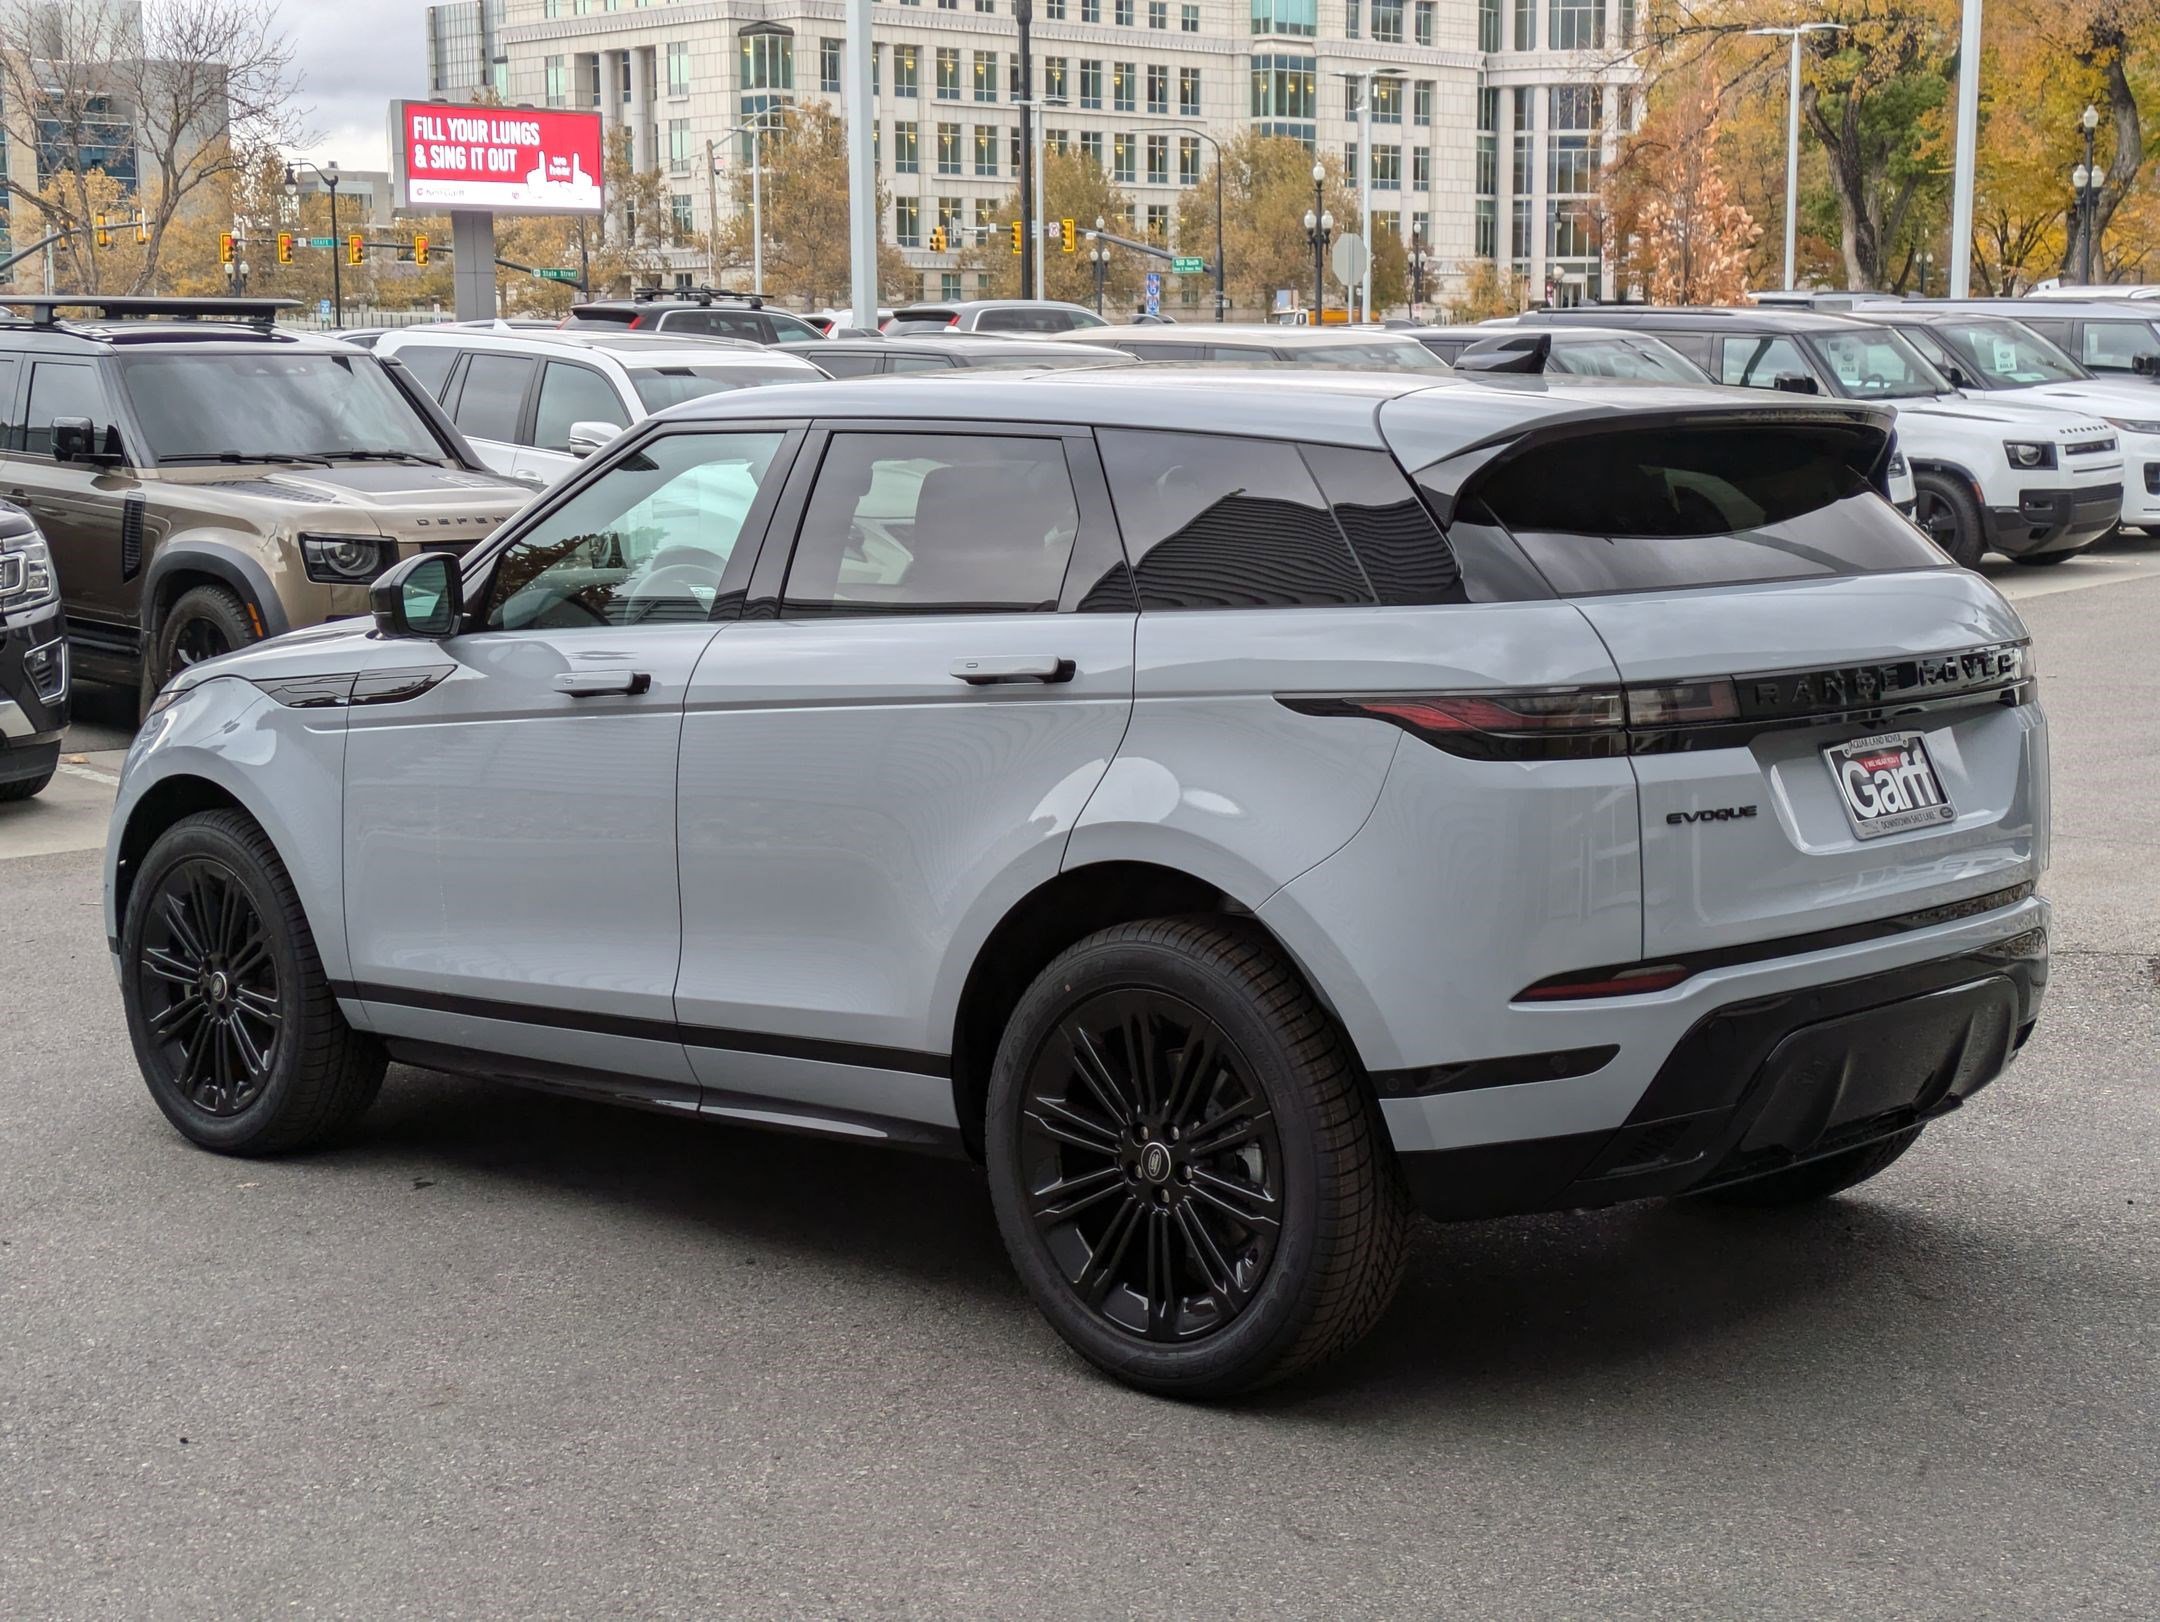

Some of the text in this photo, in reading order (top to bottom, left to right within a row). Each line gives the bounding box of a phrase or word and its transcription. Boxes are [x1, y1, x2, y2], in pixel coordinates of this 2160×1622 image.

[413, 116, 540, 146] FILL YOUR LUNGS
[414, 144, 517, 172] & SING IT OUT
[2059, 425, 2108, 434] DEFENDER
[416, 516, 507, 526] DEFEN
[1754, 652, 2014, 706] RANGE ROVER
[1869, 736, 1885, 746] LAND
[1842, 750, 1938, 818] Garff
[1666, 805, 1757, 824] EVOQUE
[1881, 816, 1911, 829] DOWNTOWN
[1911, 813, 1924, 824] SALT
[1923, 811, 1937, 821] LAKE
